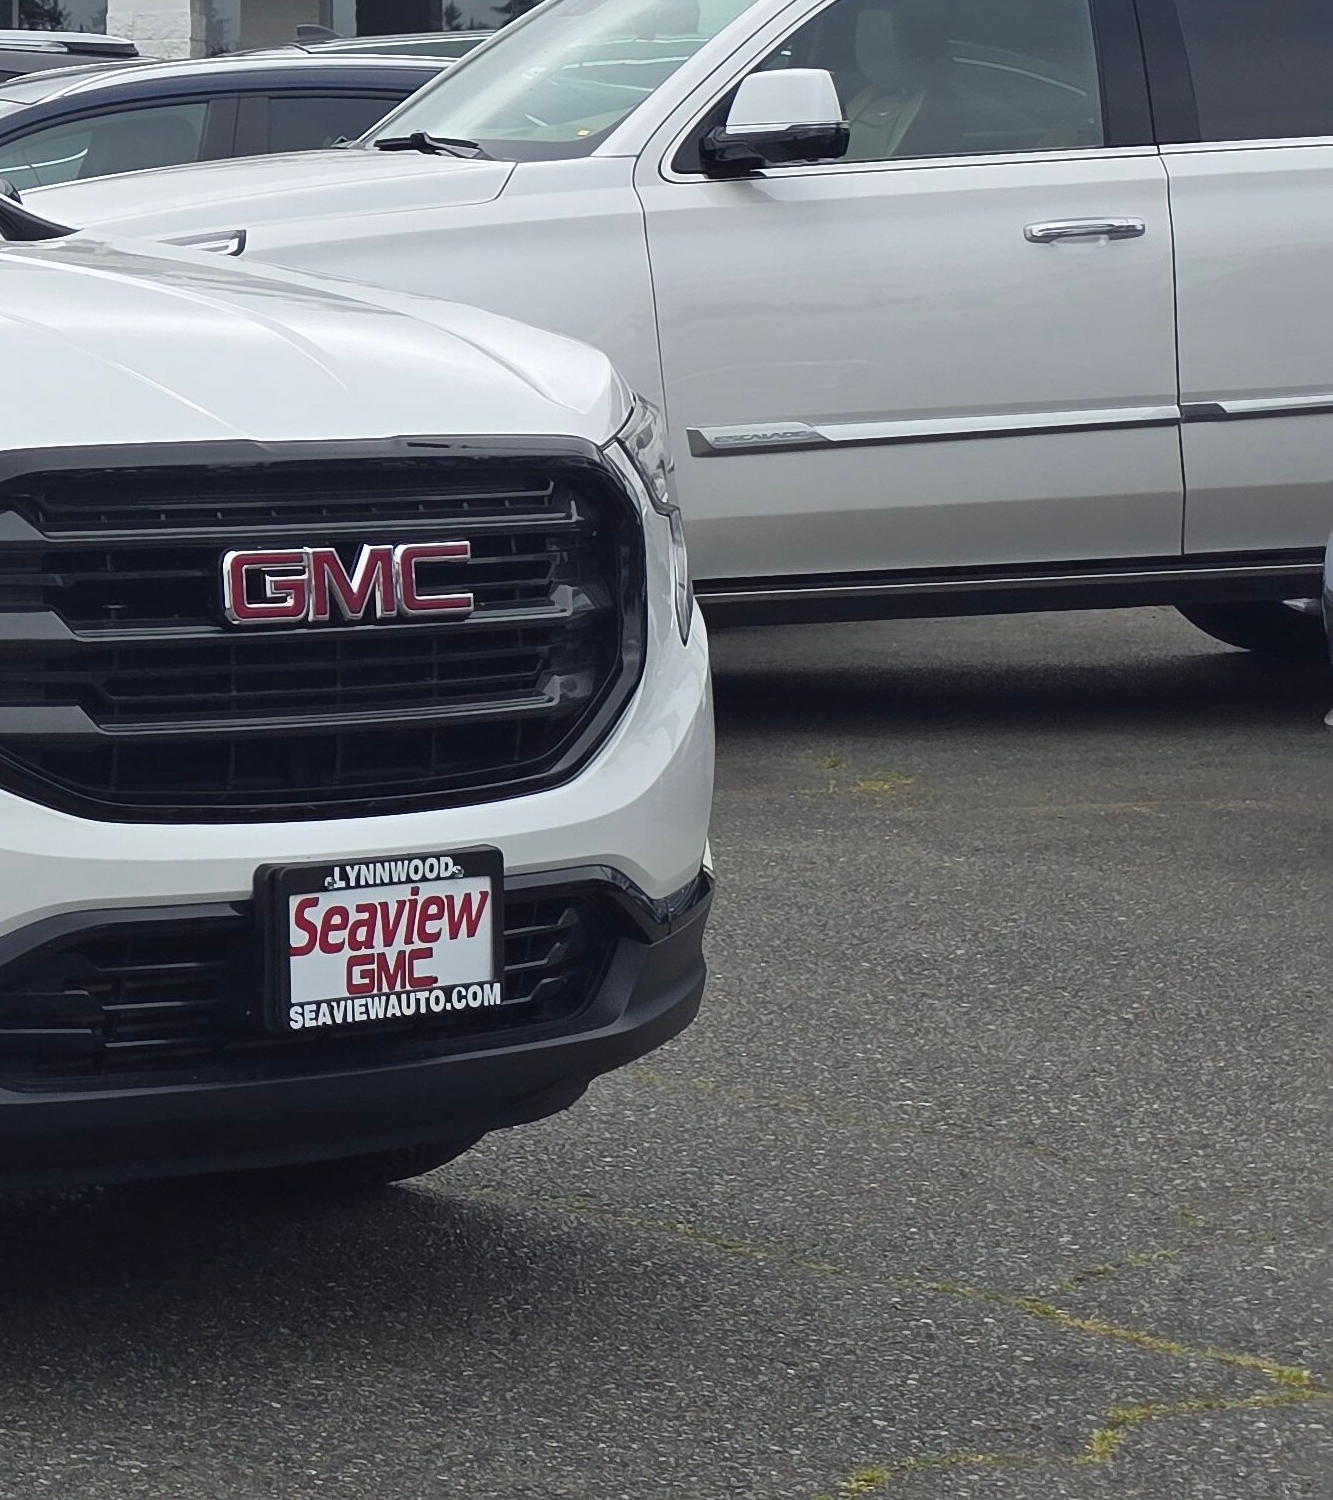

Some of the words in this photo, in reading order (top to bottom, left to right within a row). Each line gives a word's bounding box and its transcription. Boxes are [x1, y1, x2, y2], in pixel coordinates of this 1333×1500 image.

[222, 541, 474, 624] GMC
[333, 856, 454, 888] LYNNWOOD
[289, 886, 489, 957] Seaview
[346, 947, 438, 996] GMC
[289, 982, 501, 1030] SEAVIEWAUTO.COM
